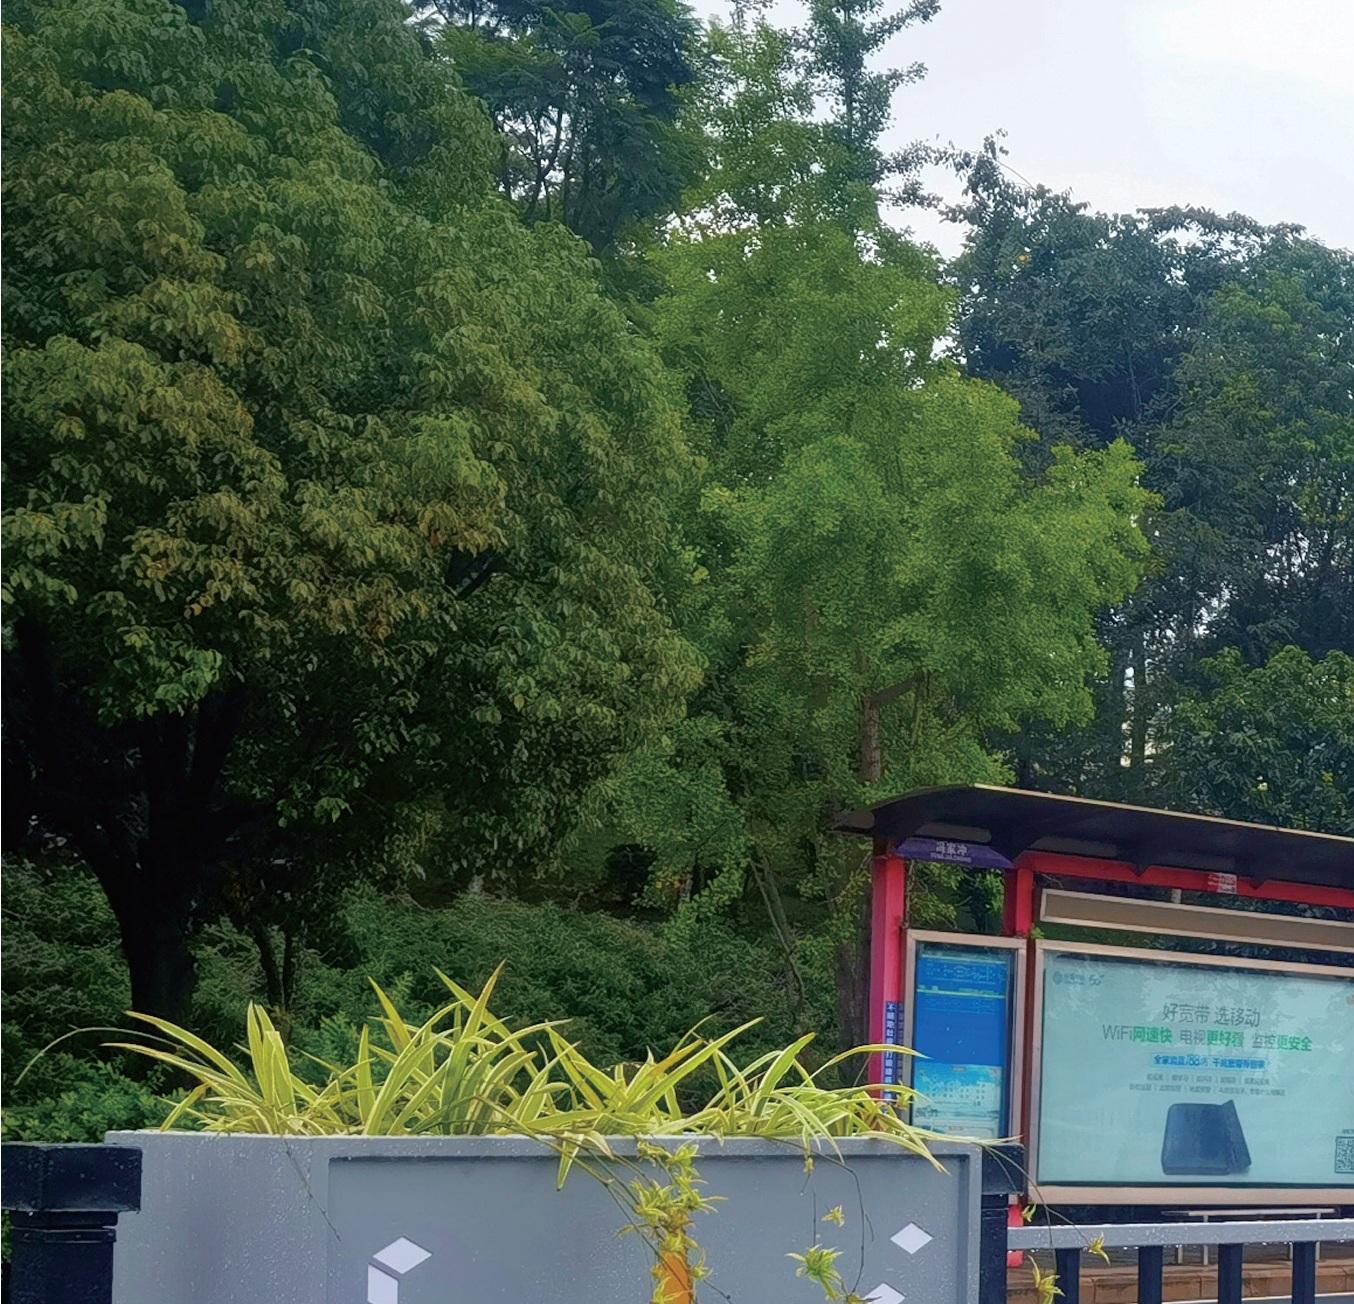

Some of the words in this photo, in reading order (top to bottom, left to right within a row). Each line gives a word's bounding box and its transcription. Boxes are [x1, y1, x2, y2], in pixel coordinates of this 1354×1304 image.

[1162, 1003, 1211, 1025] 好宽带
[1214, 1006, 1261, 1028] 选移动
[1102, 1024, 1173, 1043] WiFi网速快
[1180, 1029, 1245, 1048] 电视更好看
[1252, 1032, 1313, 1052] 监控更安全
